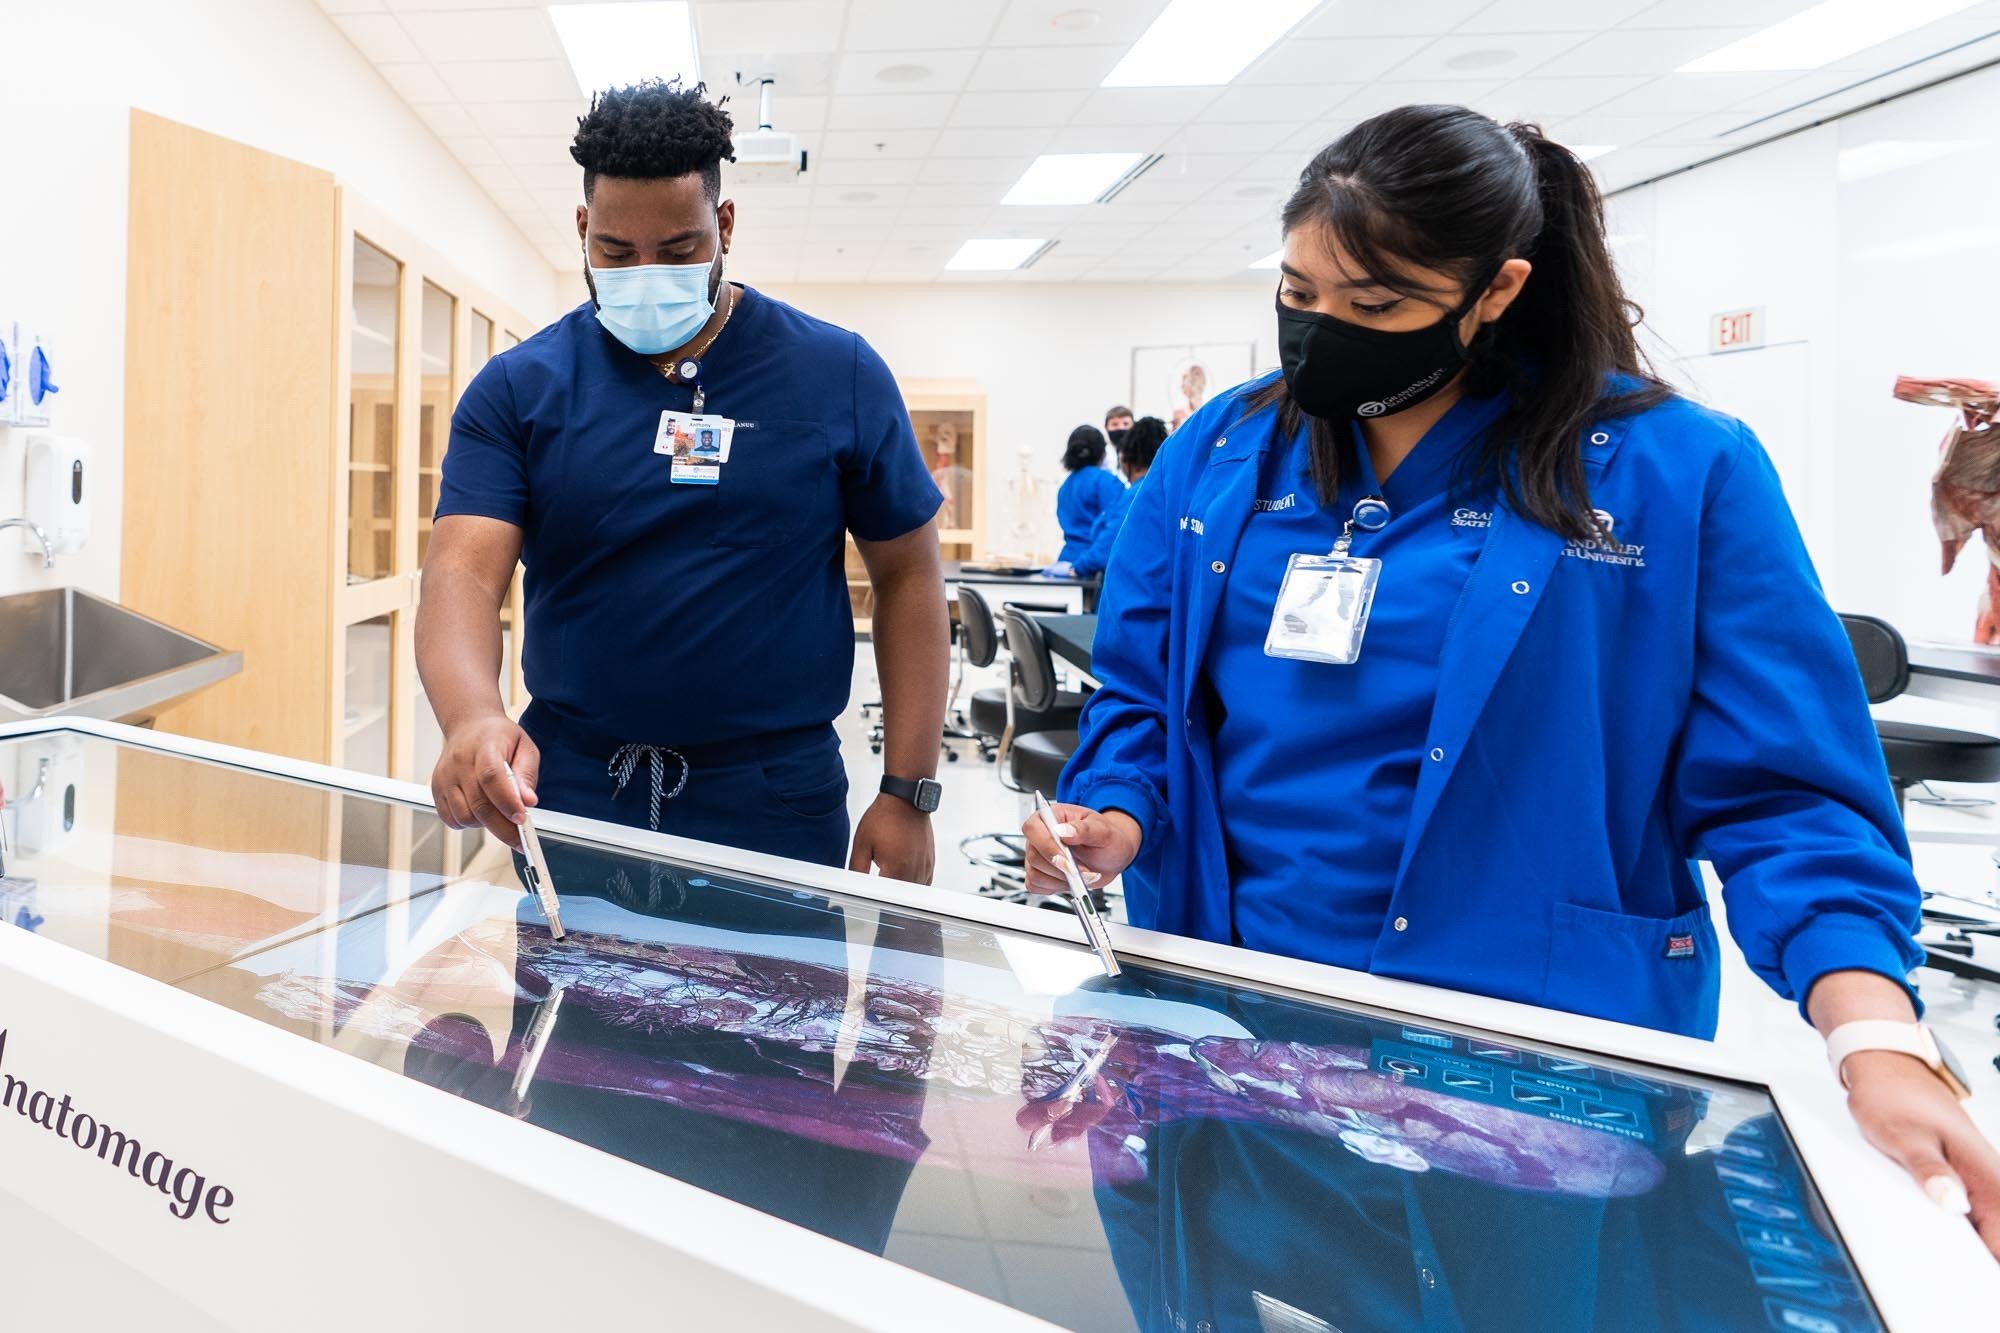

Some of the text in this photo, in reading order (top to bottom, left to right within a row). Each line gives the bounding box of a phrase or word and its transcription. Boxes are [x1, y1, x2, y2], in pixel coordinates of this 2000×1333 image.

[1720, 313, 1752, 345] EXIT
[1254, 494, 1296, 511] STUDENT
[1536, 1079, 1577, 1093] Undo
[1548, 1111, 1645, 1140] Dissection
